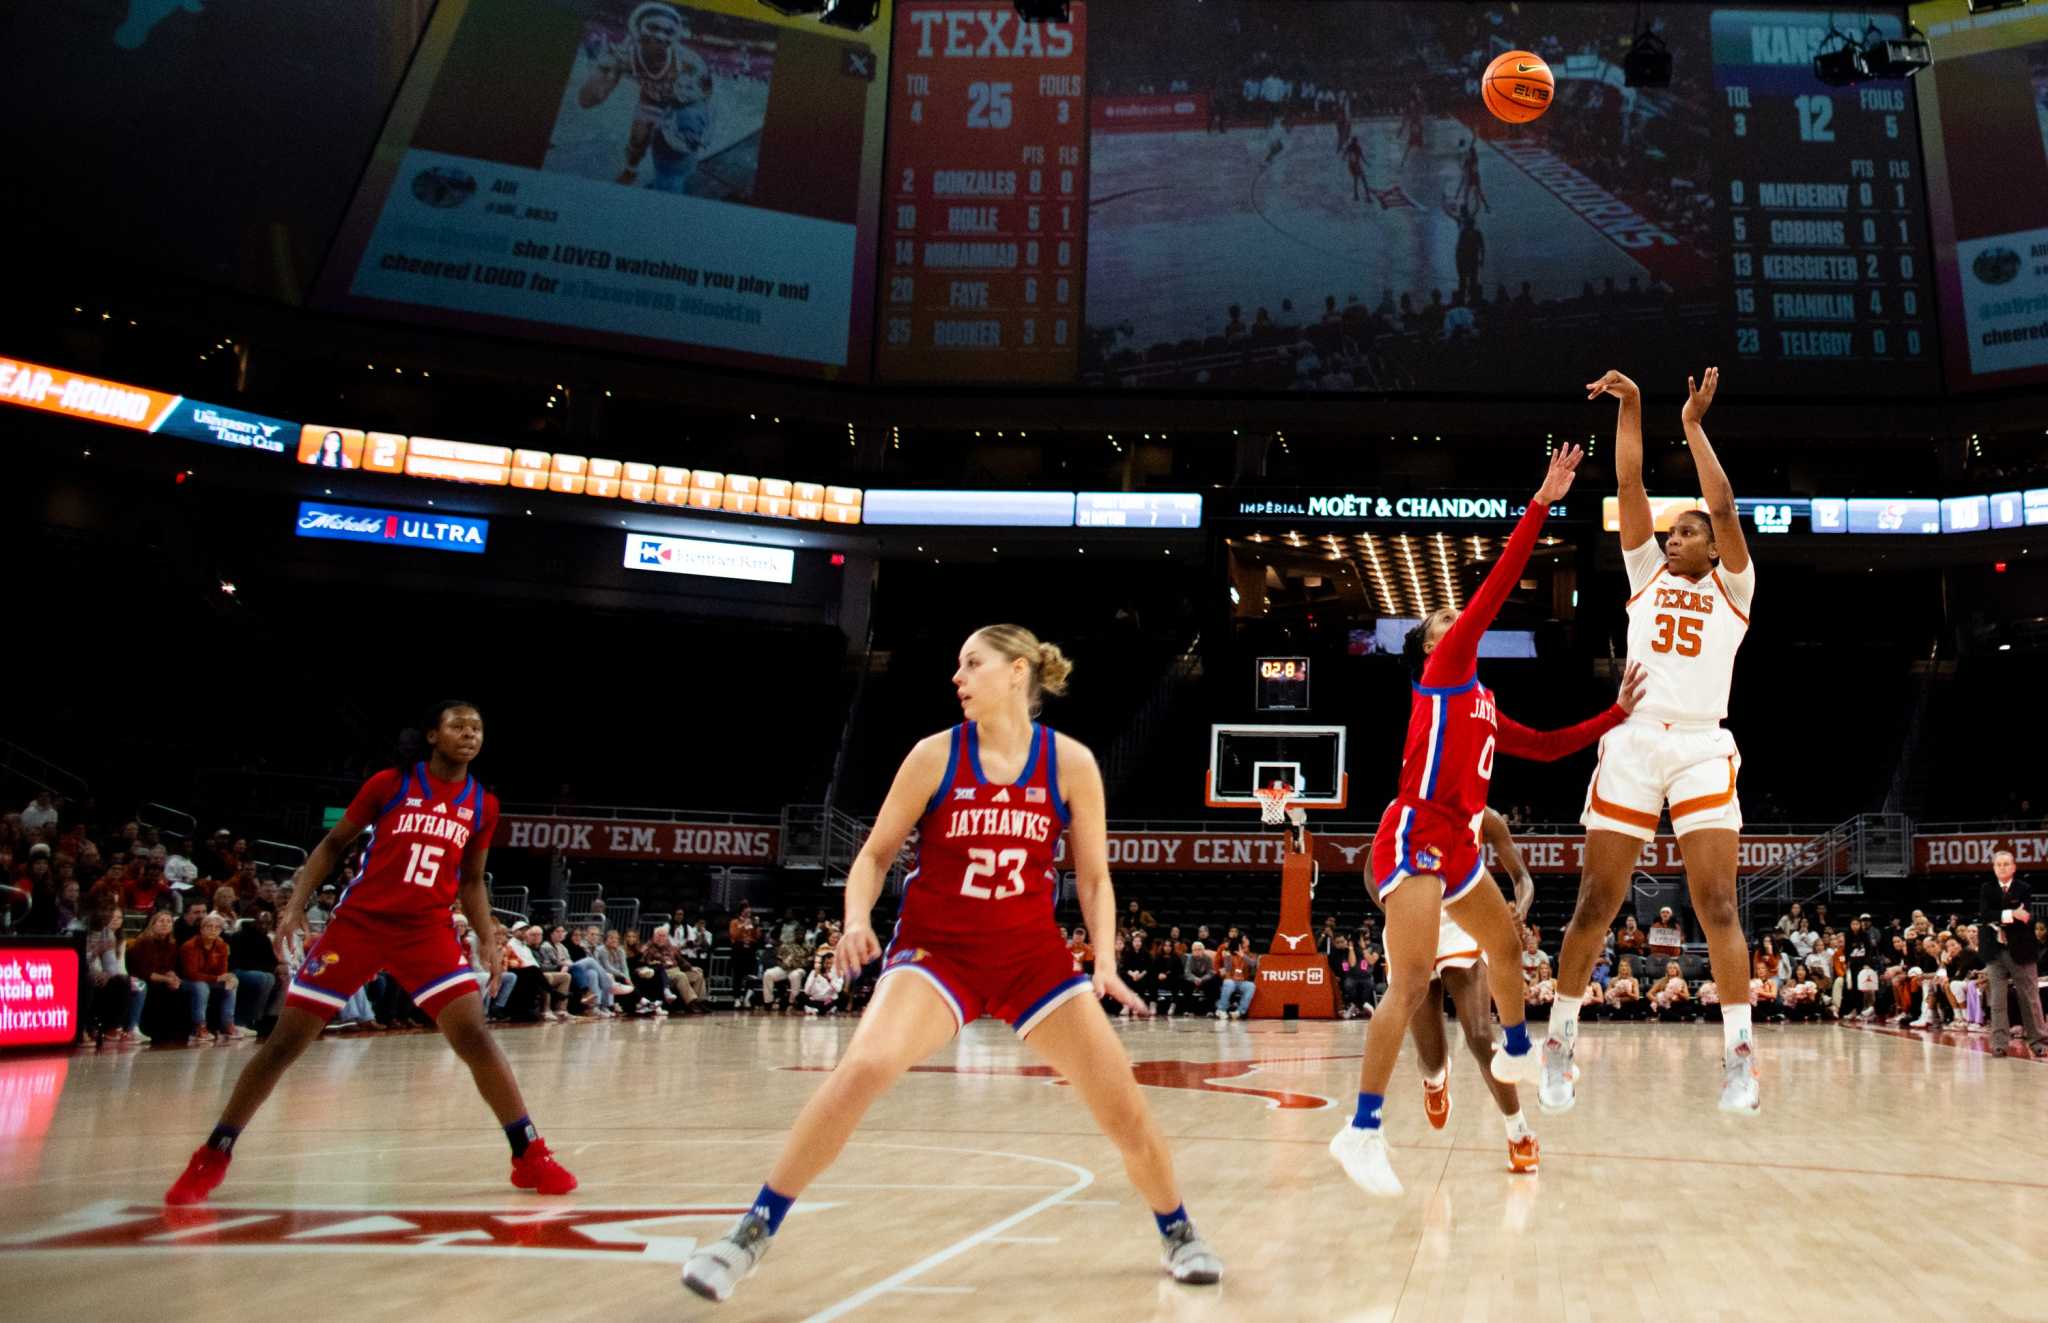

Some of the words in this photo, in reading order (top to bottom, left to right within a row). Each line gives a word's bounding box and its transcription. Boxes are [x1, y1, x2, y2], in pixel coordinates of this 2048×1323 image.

[911, 10, 1074, 58] TEXAS
[1040, 74, 1081, 96] FOULS
[1514, 83, 1549, 101] ELITE
[1727, 86, 1751, 108] TOL
[966, 82, 1014, 129] 25
[1860, 89, 1905, 110] FOULS
[1734, 114, 1746, 136] 3
[1794, 95, 1835, 141] 12
[1885, 116, 1898, 138] 5
[903, 168, 914, 193] 2
[1030, 170, 1041, 193] 0
[1851, 160, 1873, 177] PTS
[1889, 161, 1910, 178] FLS
[1731, 180, 1744, 203] 0
[1860, 183, 1872, 207] 0
[1896, 184, 1904, 207] 1
[1062, 207, 1070, 230] 1
[1733, 217, 1746, 241] 5
[1862, 219, 1876, 243] 0
[1900, 220, 1908, 243] 1
[380, 253, 470, 281] cheered
[472, 264, 526, 289] LOUD
[529, 274, 560, 294] for
[513, 241, 551, 261] she
[552, 245, 611, 270] LOVED
[615, 256, 699, 286] watching
[703, 270, 735, 290] you
[736, 276, 775, 298] play
[778, 283, 809, 301] and
[1733, 254, 1752, 276] 13
[1867, 255, 1878, 278] 2
[1902, 255, 1913, 279] 0
[1736, 289, 1754, 313] 15
[1738, 329, 1759, 353] 23
[1874, 330, 1886, 353] 0
[1308, 494, 1368, 517] MOËT
[1375, 499, 1393, 517] &
[1396, 498, 1507, 518] CHANDON
[1510, 506, 1567, 516] LOGE
[402, 520, 483, 545] ULTRA
[1654, 588, 1714, 615] TEXAS
[1651, 613, 1704, 658] 35
[1261, 661, 1295, 678] 02.8
[1477, 735, 1495, 780] 0
[392, 813, 470, 849] JAYHAWKS
[945, 808, 1051, 842] JAYHAWKS
[508, 821, 593, 850] HOOK
[673, 828, 771, 857] HORNS
[404, 842, 445, 887] 15
[1928, 840, 1999, 865] HOOK
[960, 848, 1028, 900] 23
[26, 960, 52, 979] 'em
[1262, 971, 1305, 981] TRUIST
[35, 983, 54, 999] on
